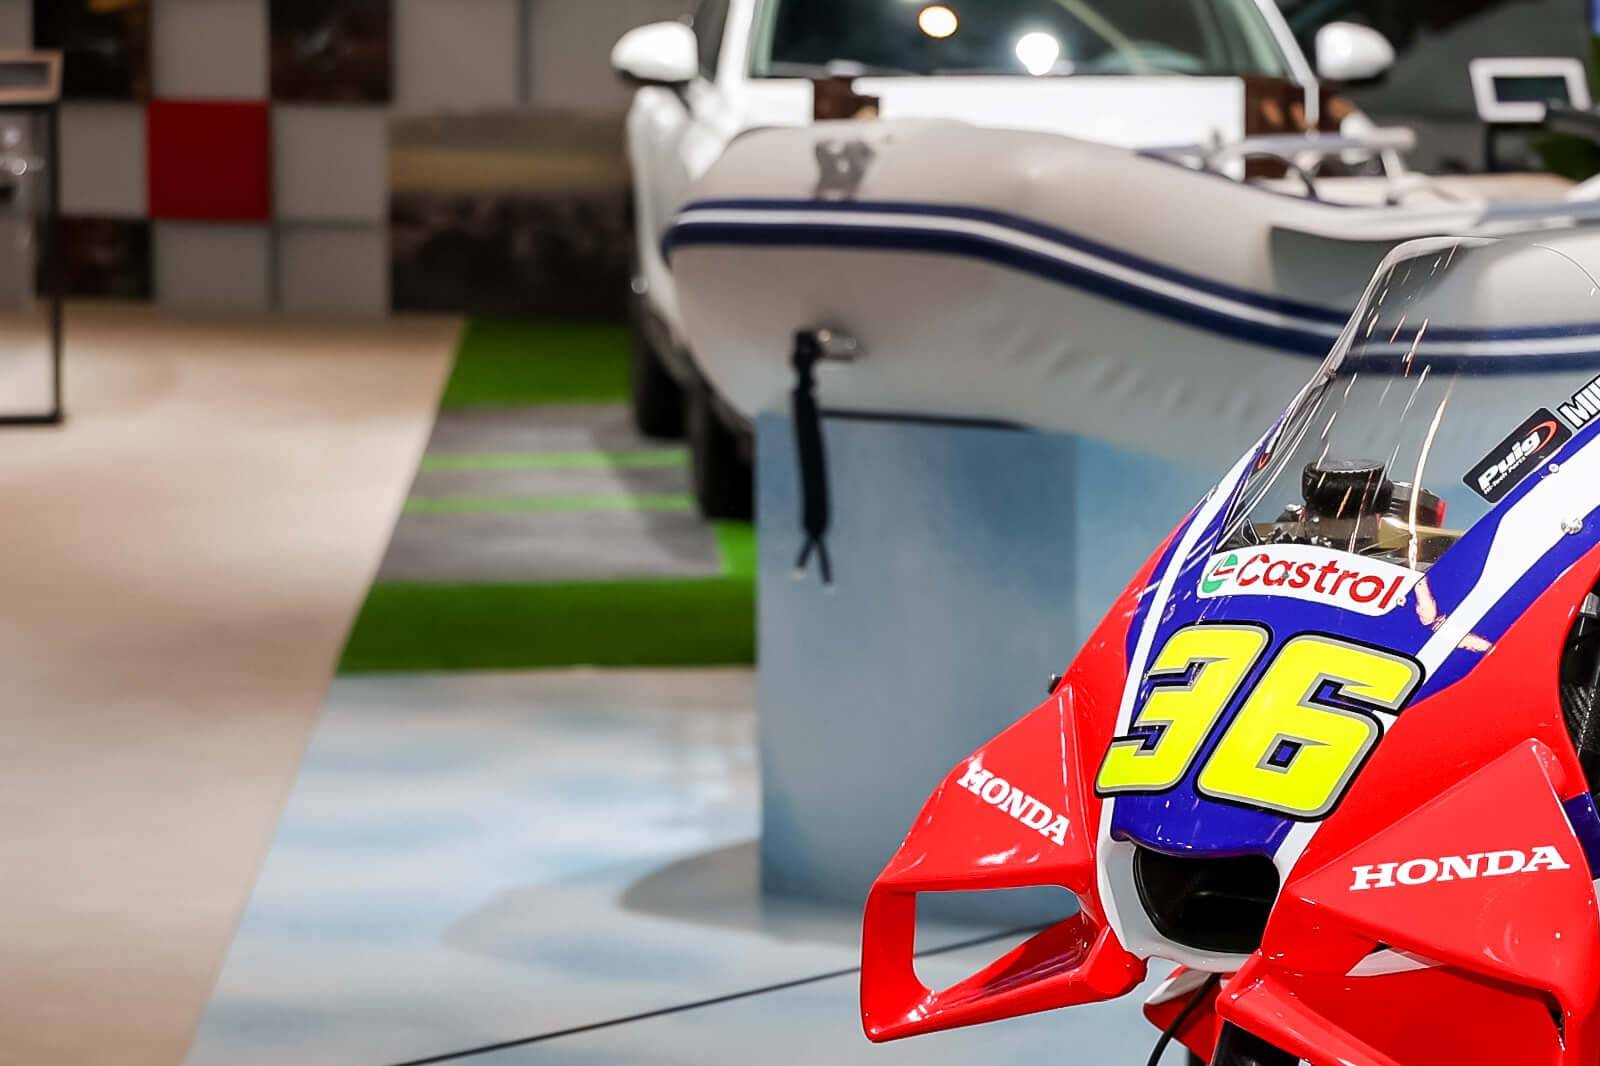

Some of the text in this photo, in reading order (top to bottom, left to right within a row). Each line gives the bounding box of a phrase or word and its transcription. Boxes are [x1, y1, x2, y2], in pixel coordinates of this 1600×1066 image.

[1477, 431, 1542, 491] Puig
[1236, 553, 1405, 610] Castrol
[1095, 622, 1425, 821] 36
[957, 761, 1071, 847] HONDA
[1349, 845, 1571, 892] HONDA
